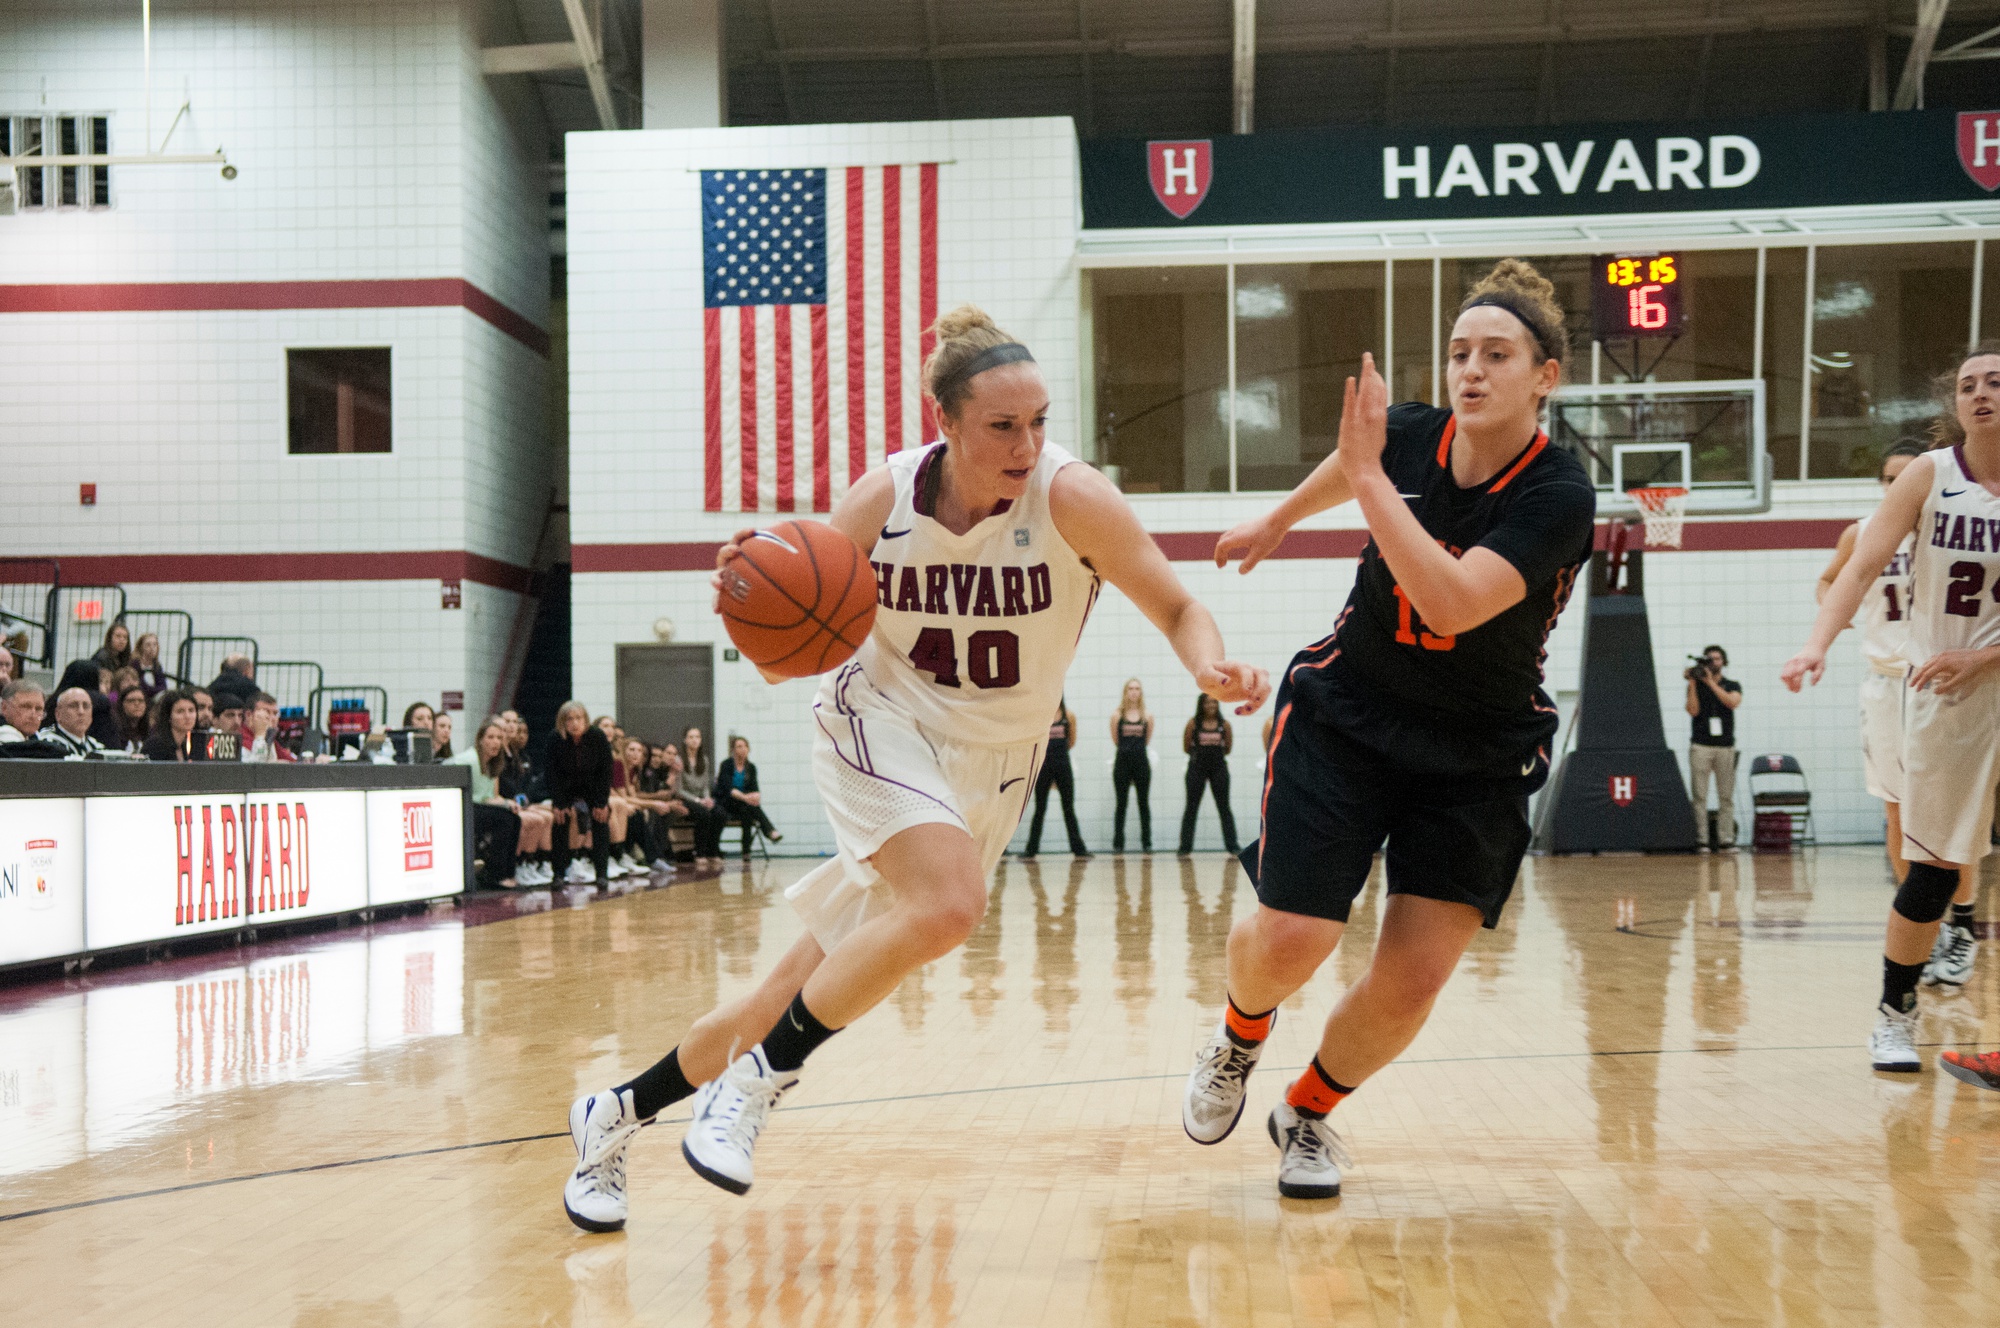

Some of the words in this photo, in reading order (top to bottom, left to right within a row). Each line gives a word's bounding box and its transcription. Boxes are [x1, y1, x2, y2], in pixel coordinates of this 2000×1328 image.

[1162, 148, 1198, 196] H
[1383, 134, 1761, 200] HARVARD
[1607, 256, 1677, 287] 13:15
[1629, 285, 1667, 329] 16
[870, 561, 1052, 617] HARVARD
[1884, 583, 1914, 621] 1
[1944, 560, 2000, 617] 2
[908, 627, 1020, 689] 40
[1614, 776, 1632, 800] H
[174, 803, 310, 926] HARVARD
